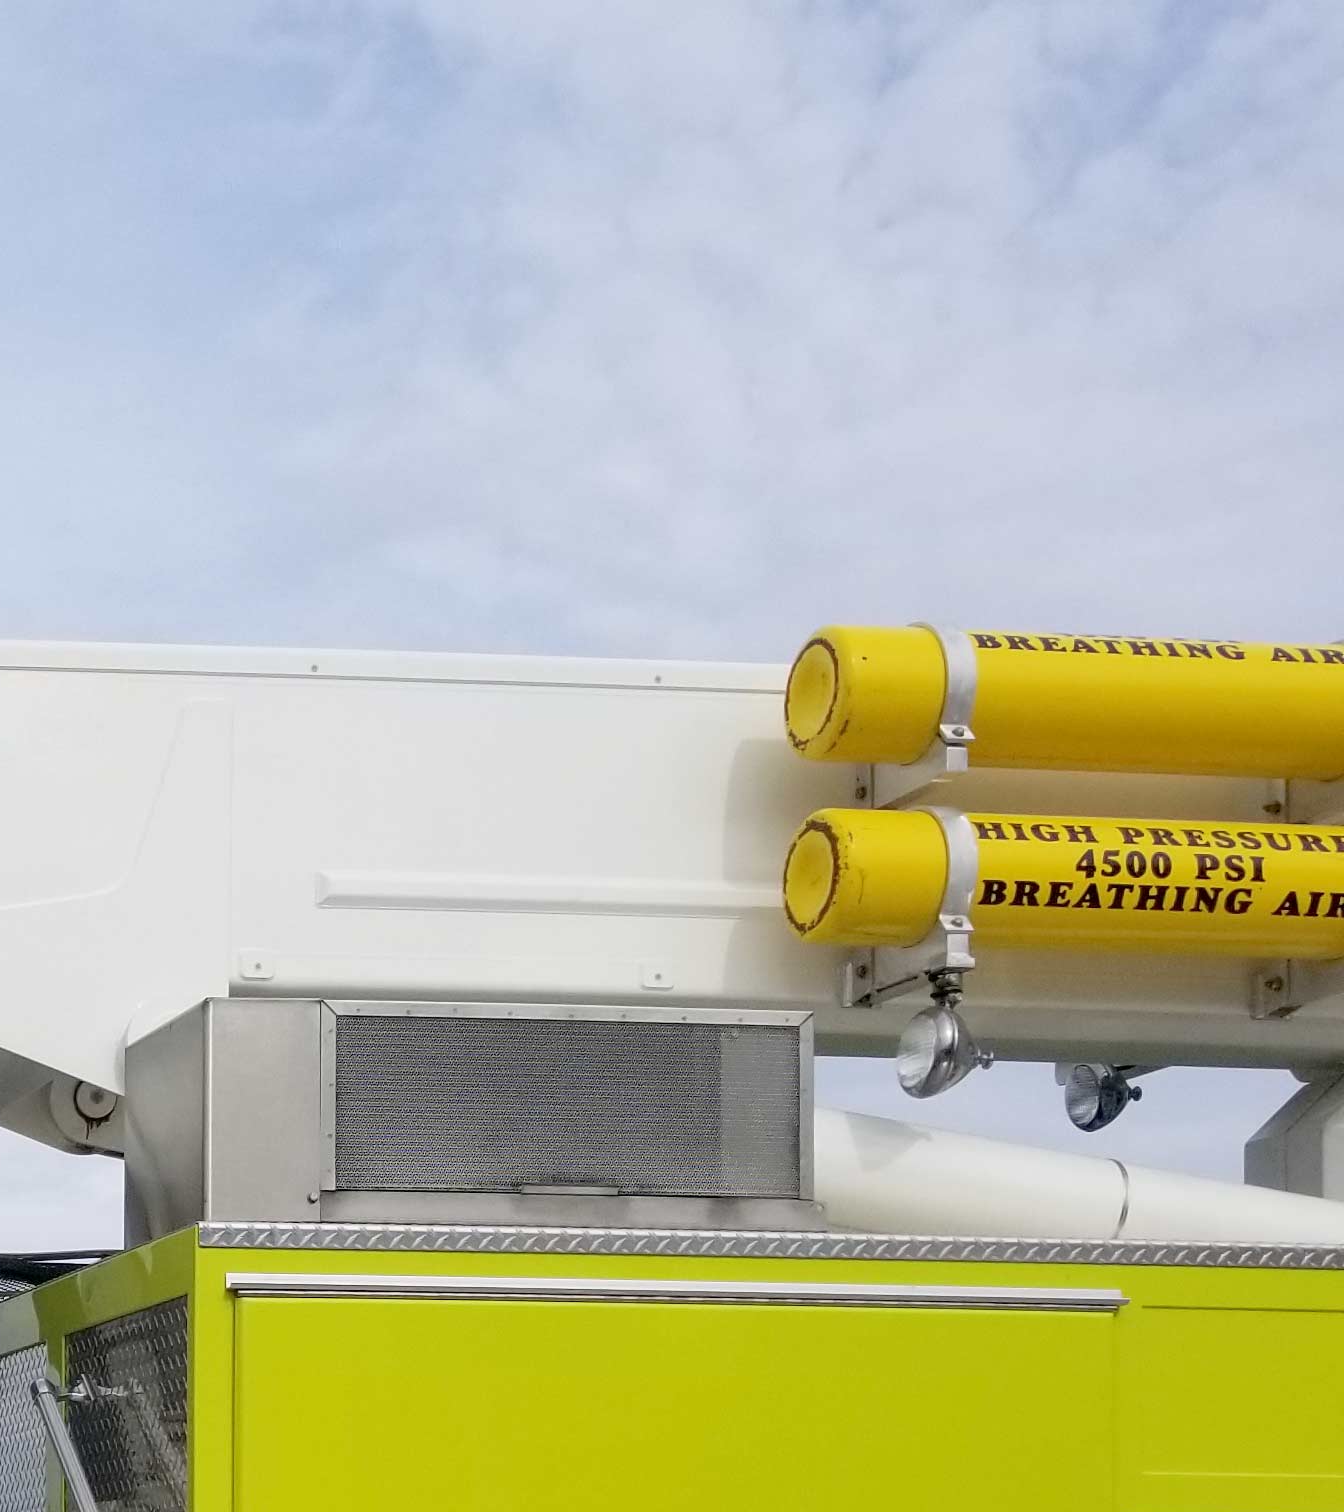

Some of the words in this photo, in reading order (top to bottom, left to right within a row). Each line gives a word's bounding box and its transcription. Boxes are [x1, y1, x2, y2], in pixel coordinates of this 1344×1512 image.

[969, 633, 1246, 660] BREATHING
[1271, 647, 1344, 665] AIR
[973, 821, 1099, 844] HIGH
[1075, 848, 1173, 879] 4500
[1194, 853, 1267, 883] PSI
[977, 879, 1254, 915] BREATHING
[1271, 890, 1344, 919] AIR
